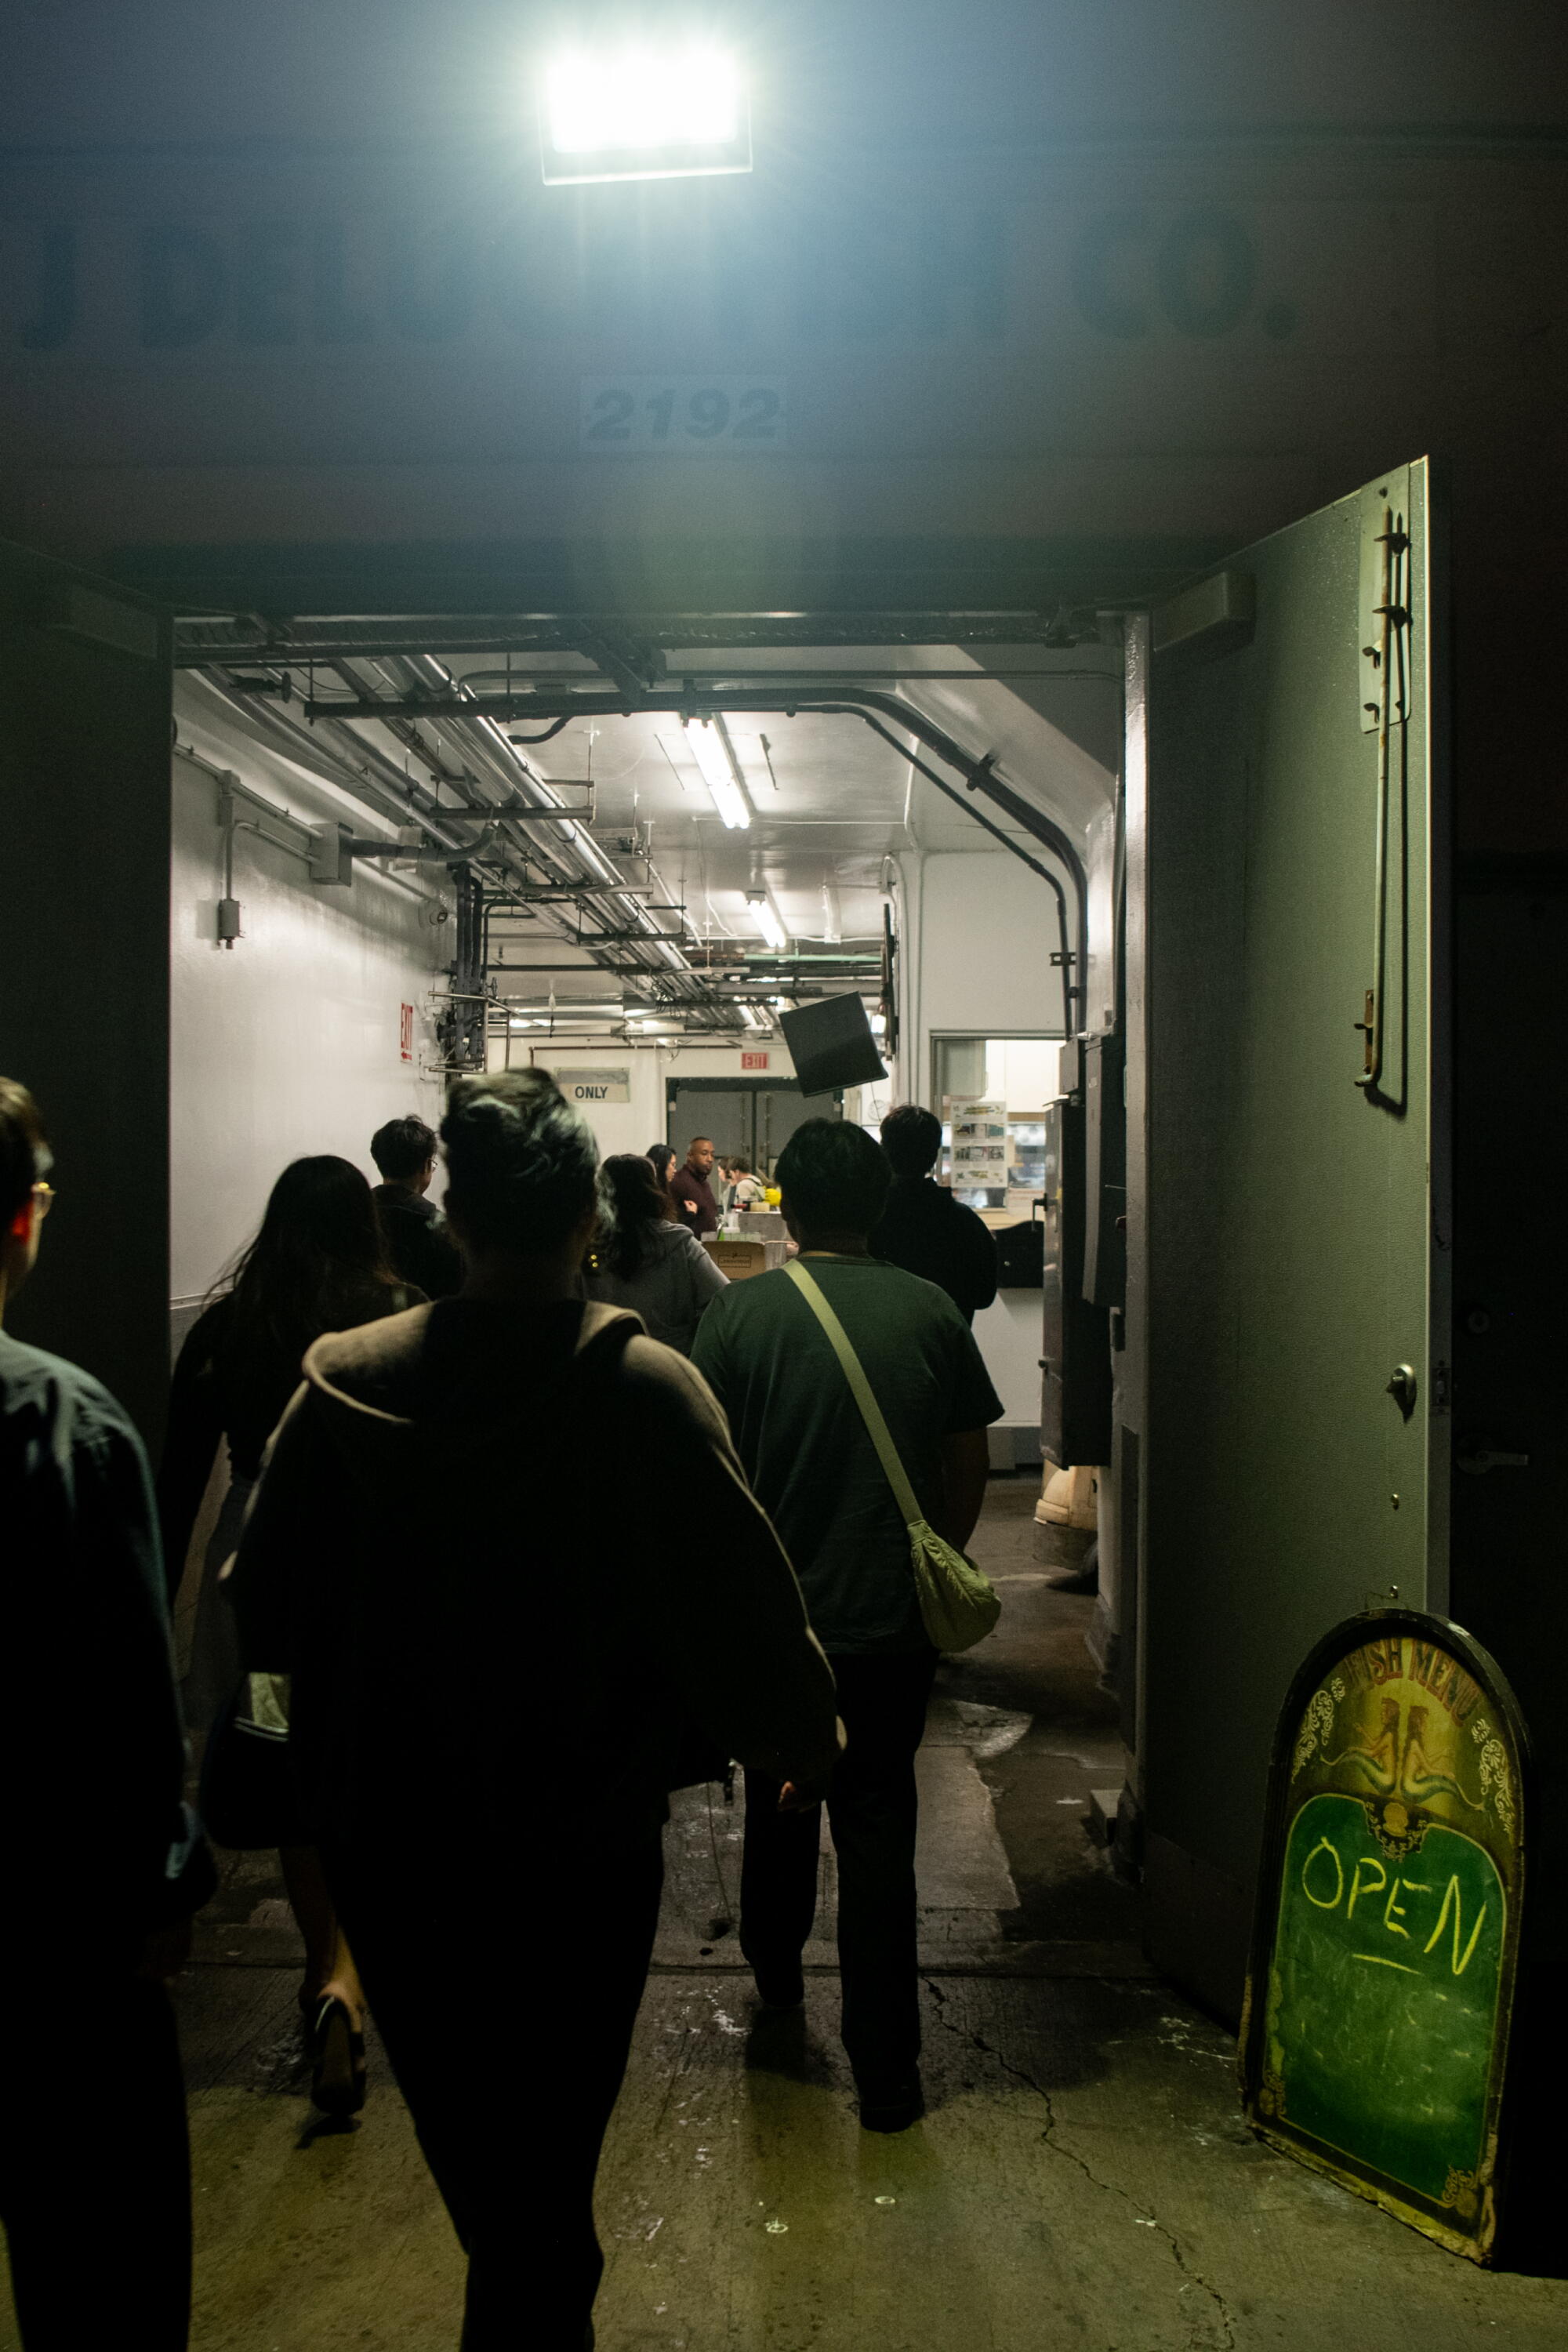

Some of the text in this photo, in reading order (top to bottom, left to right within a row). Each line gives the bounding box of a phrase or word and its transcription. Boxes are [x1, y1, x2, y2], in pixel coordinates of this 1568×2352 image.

[586, 388, 785, 441] 2192
[575, 1086, 609, 1099] ONLY
[1343, 1639, 1480, 1728] FISH MENU
[1301, 1836, 1487, 1975] OPEN
